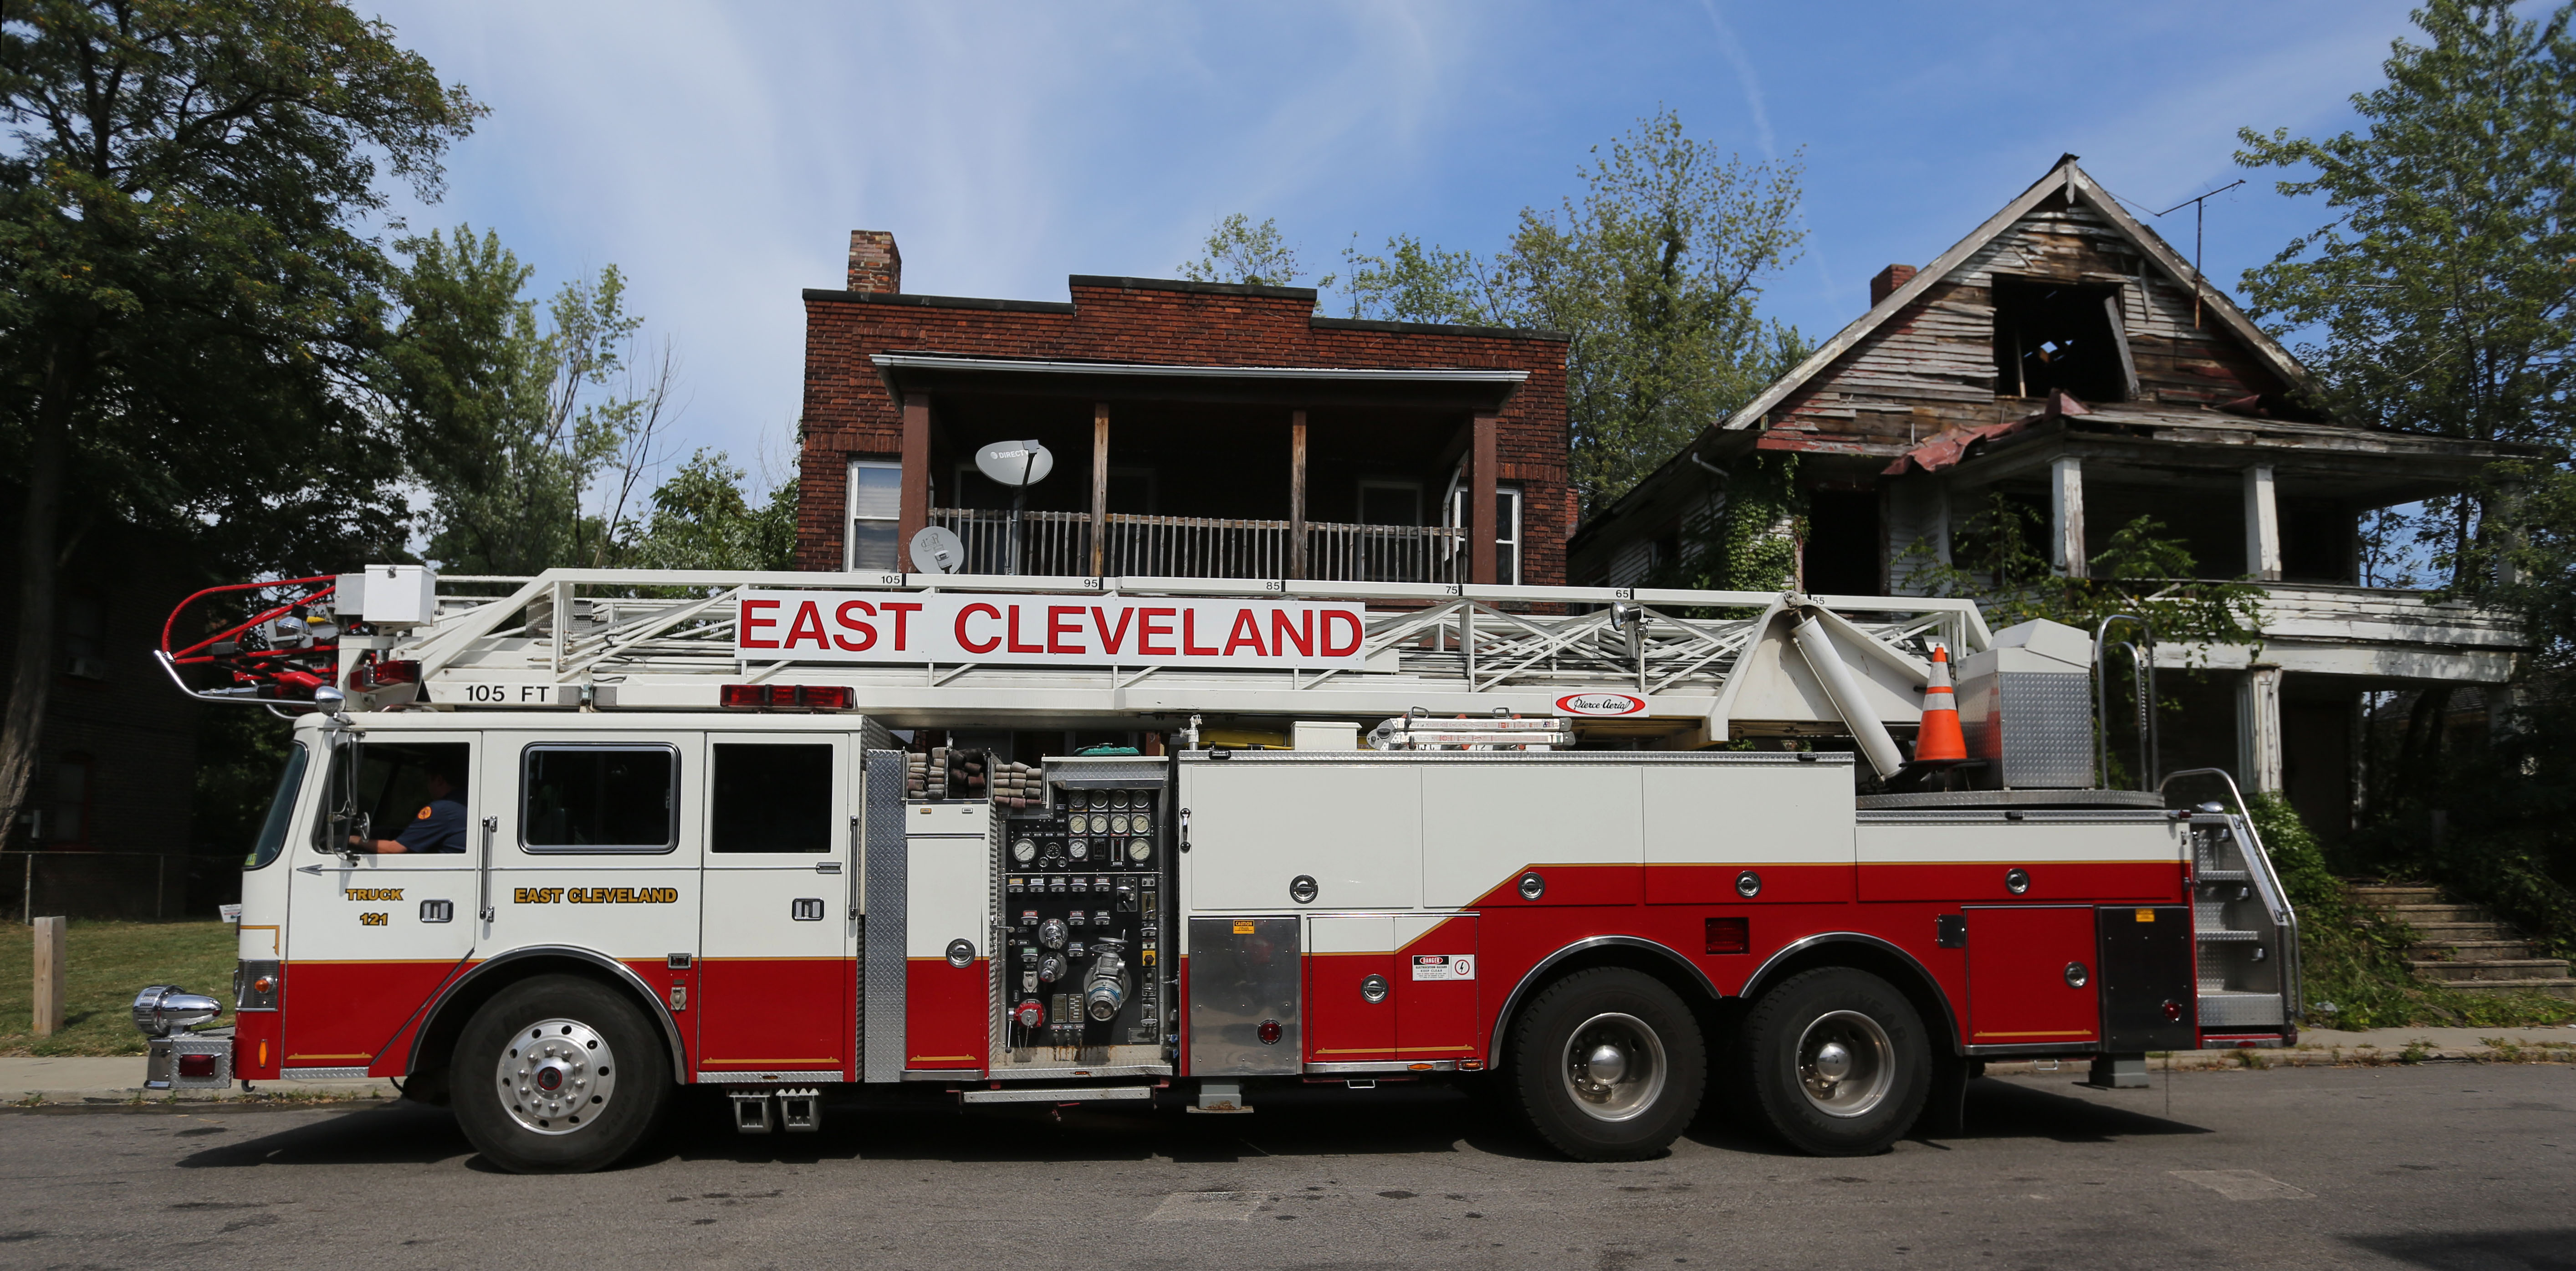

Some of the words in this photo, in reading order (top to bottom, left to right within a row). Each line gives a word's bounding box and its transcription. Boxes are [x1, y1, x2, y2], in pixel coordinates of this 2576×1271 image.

[880, 575, 900, 584] 105
[1084, 579, 1098, 588] 95
[1266, 581, 1280, 590] 85
[1445, 586, 1457, 594] 75
[1616, 589, 1629, 598] 65
[1813, 597, 1825, 605] 55
[739, 599, 923, 651] EAST
[954, 602, 1363, 657] CLEVELAND
[465, 685, 505, 702] 105
[521, 686, 550, 702] FT
[345, 888, 404, 901] TRUCK
[514, 887, 564, 904] EAST
[567, 887, 678, 904] CLEVELAND
[359, 912, 388, 926] 121
